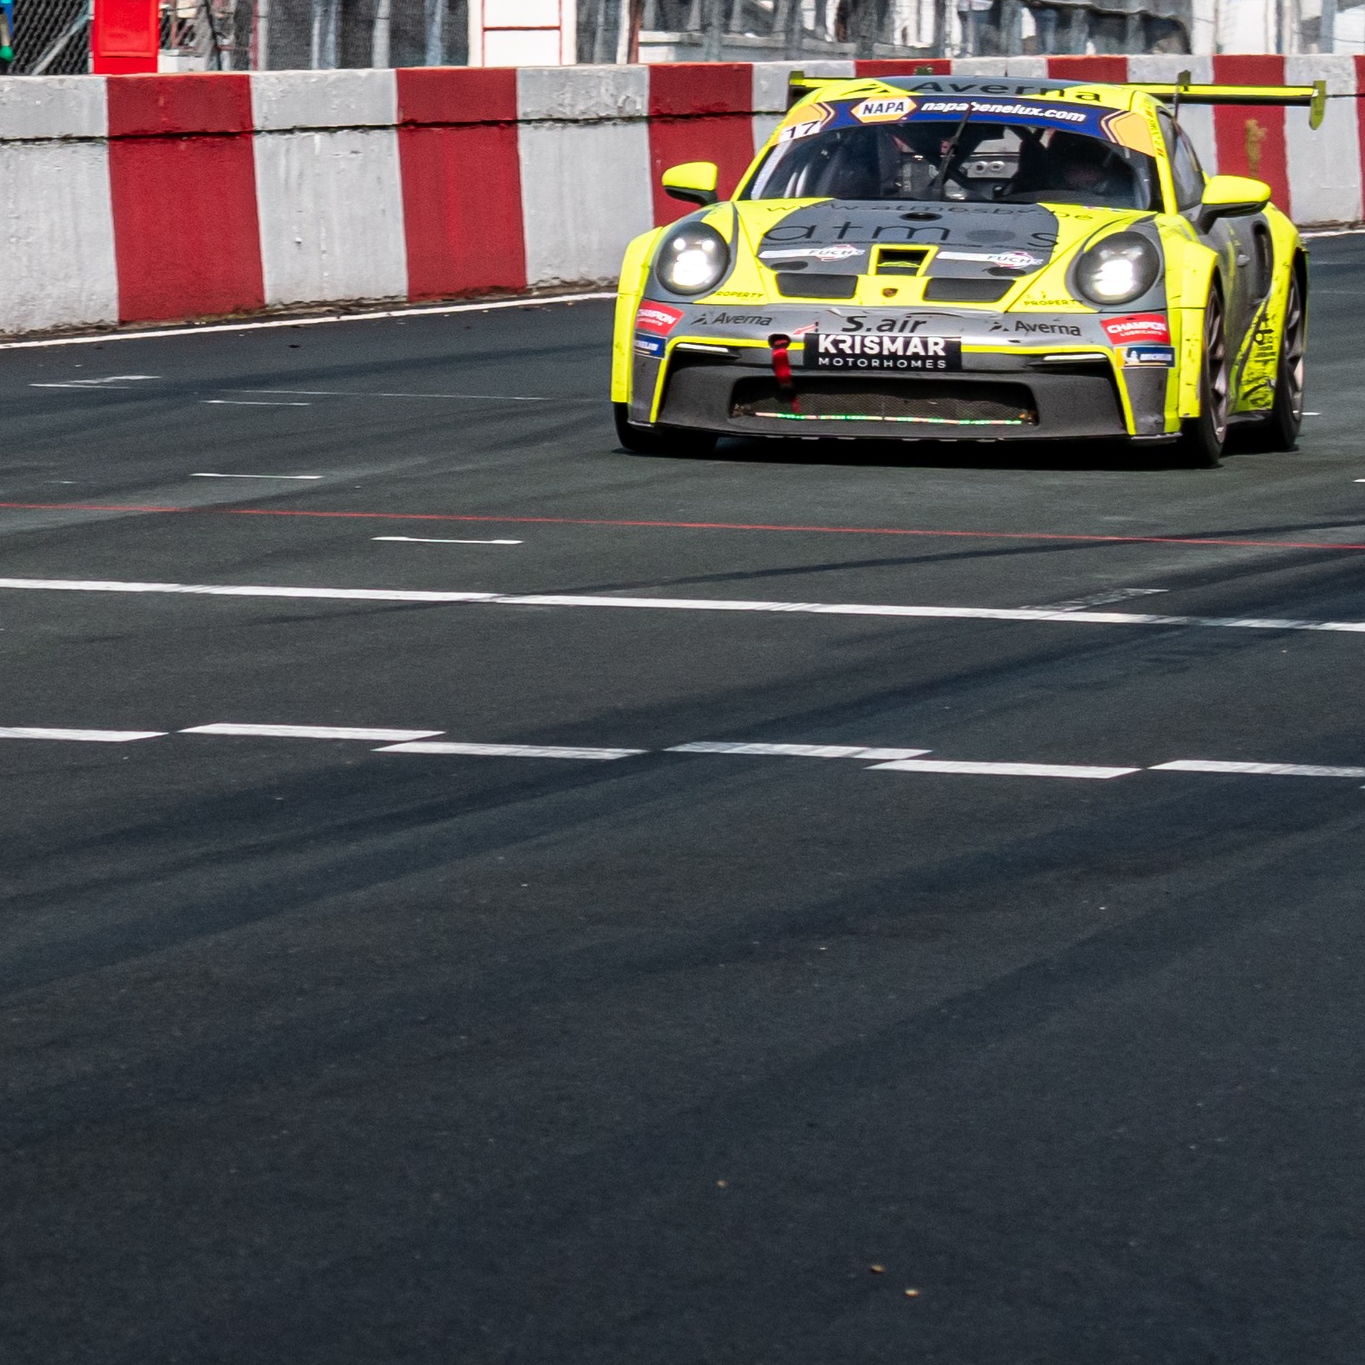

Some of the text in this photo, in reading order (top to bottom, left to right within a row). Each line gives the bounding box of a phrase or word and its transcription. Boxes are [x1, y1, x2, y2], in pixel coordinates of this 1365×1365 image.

[911, 80, 1101, 103] Averna
[862, 101, 905, 116] NAPA
[785, 120, 820, 139] 17
[809, 248, 866, 257] FUCHS
[987, 255, 1044, 265] FUCHS
[1023, 298, 1083, 306] PROPERTY
[638, 308, 677, 325] HAMPION
[711, 312, 773, 326] Averna
[841, 315, 928, 334] S.air
[1015, 320, 1082, 337] Averna
[819, 334, 947, 357] KRISMAR
[818, 357, 947, 369] MOTORHOMES
